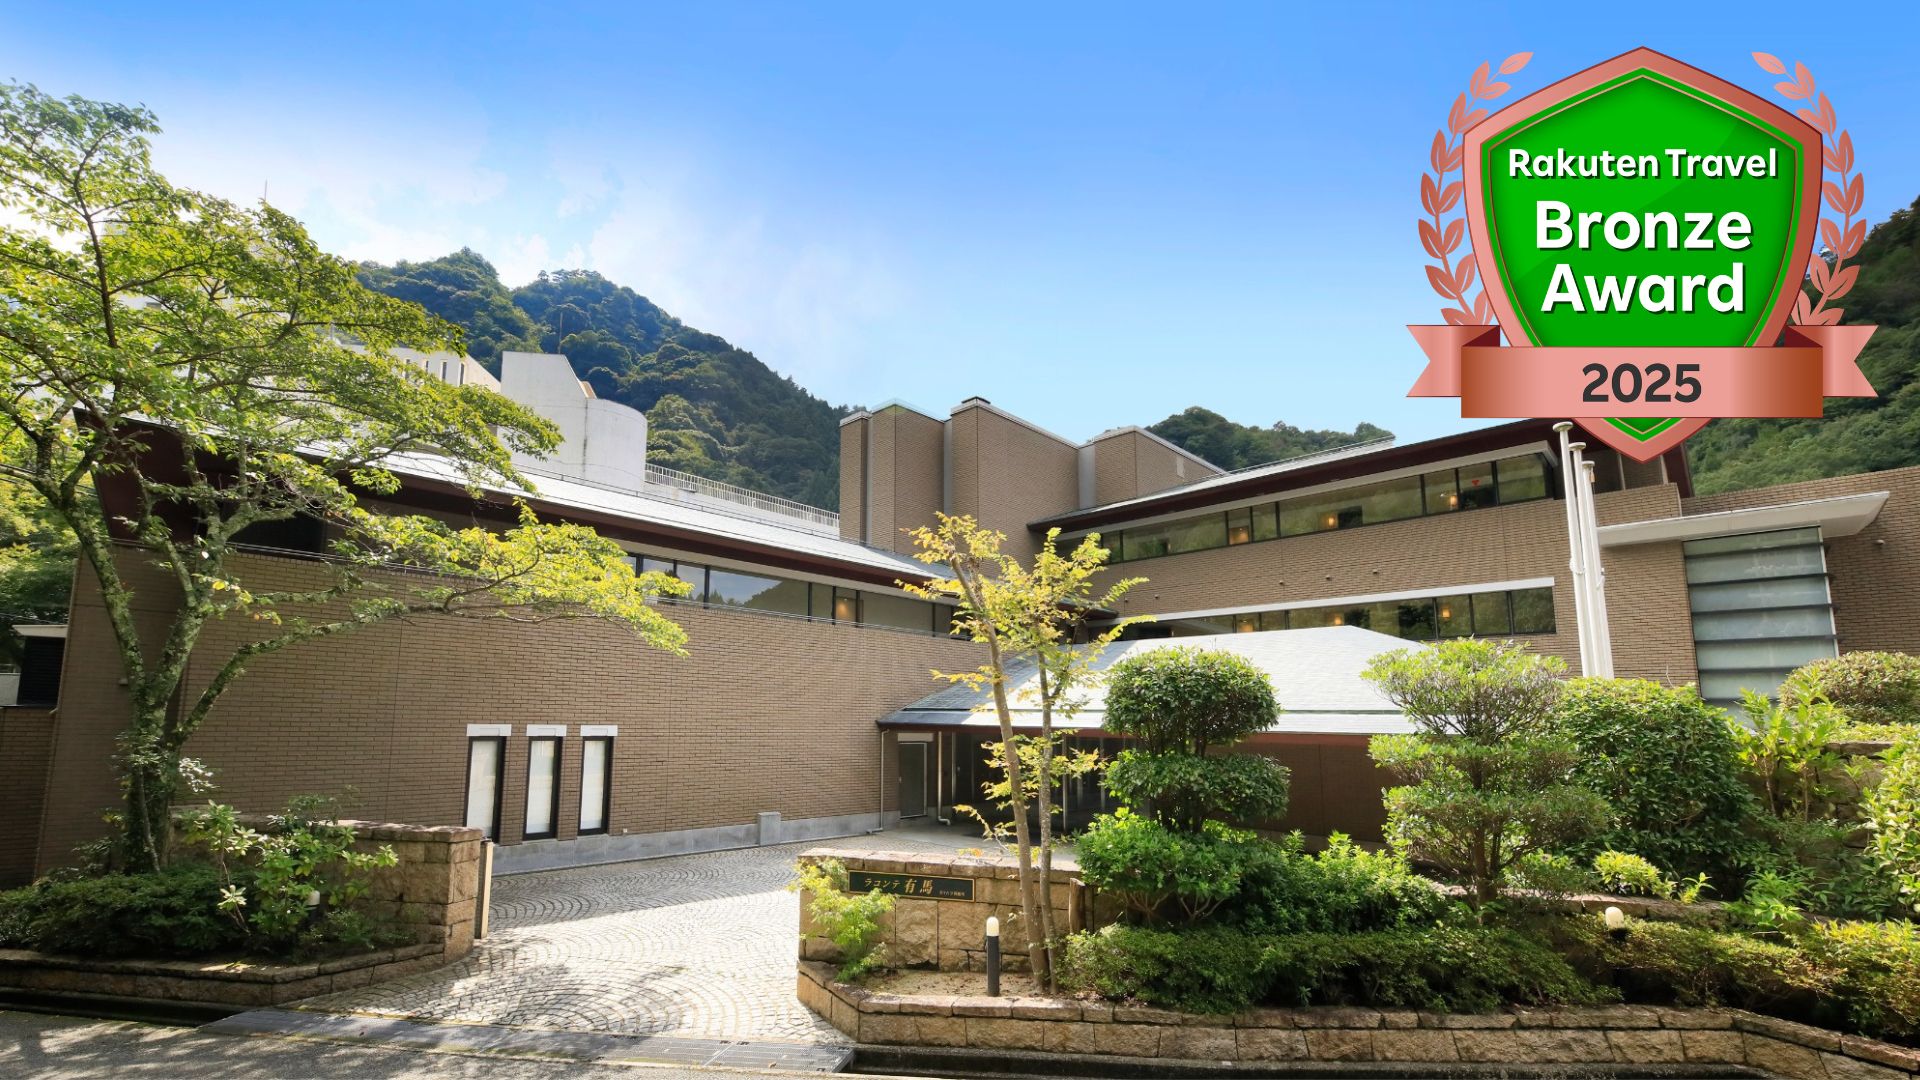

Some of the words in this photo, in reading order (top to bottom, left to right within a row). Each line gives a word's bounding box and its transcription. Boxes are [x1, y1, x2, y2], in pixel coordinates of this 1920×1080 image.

[864, 878, 935, 895] ラコンテ有馬
